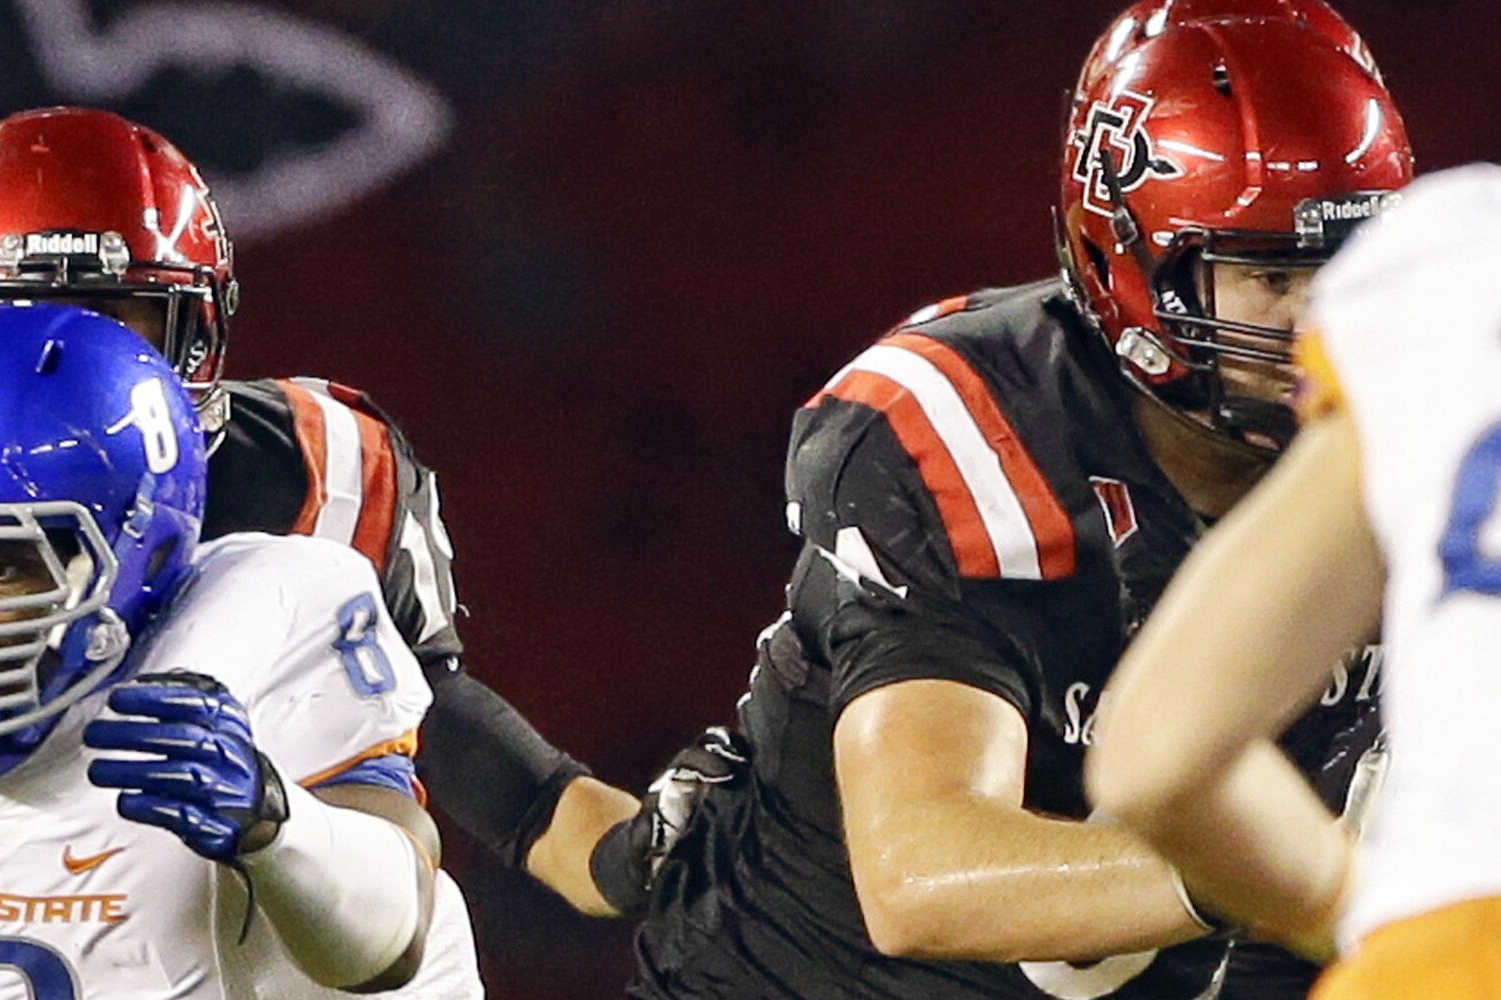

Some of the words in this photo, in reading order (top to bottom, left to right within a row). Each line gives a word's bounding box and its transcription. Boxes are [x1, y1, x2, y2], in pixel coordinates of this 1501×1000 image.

[26, 233, 98, 255] Riddell
[131, 377, 180, 474] 8
[333, 590, 398, 698] 8
